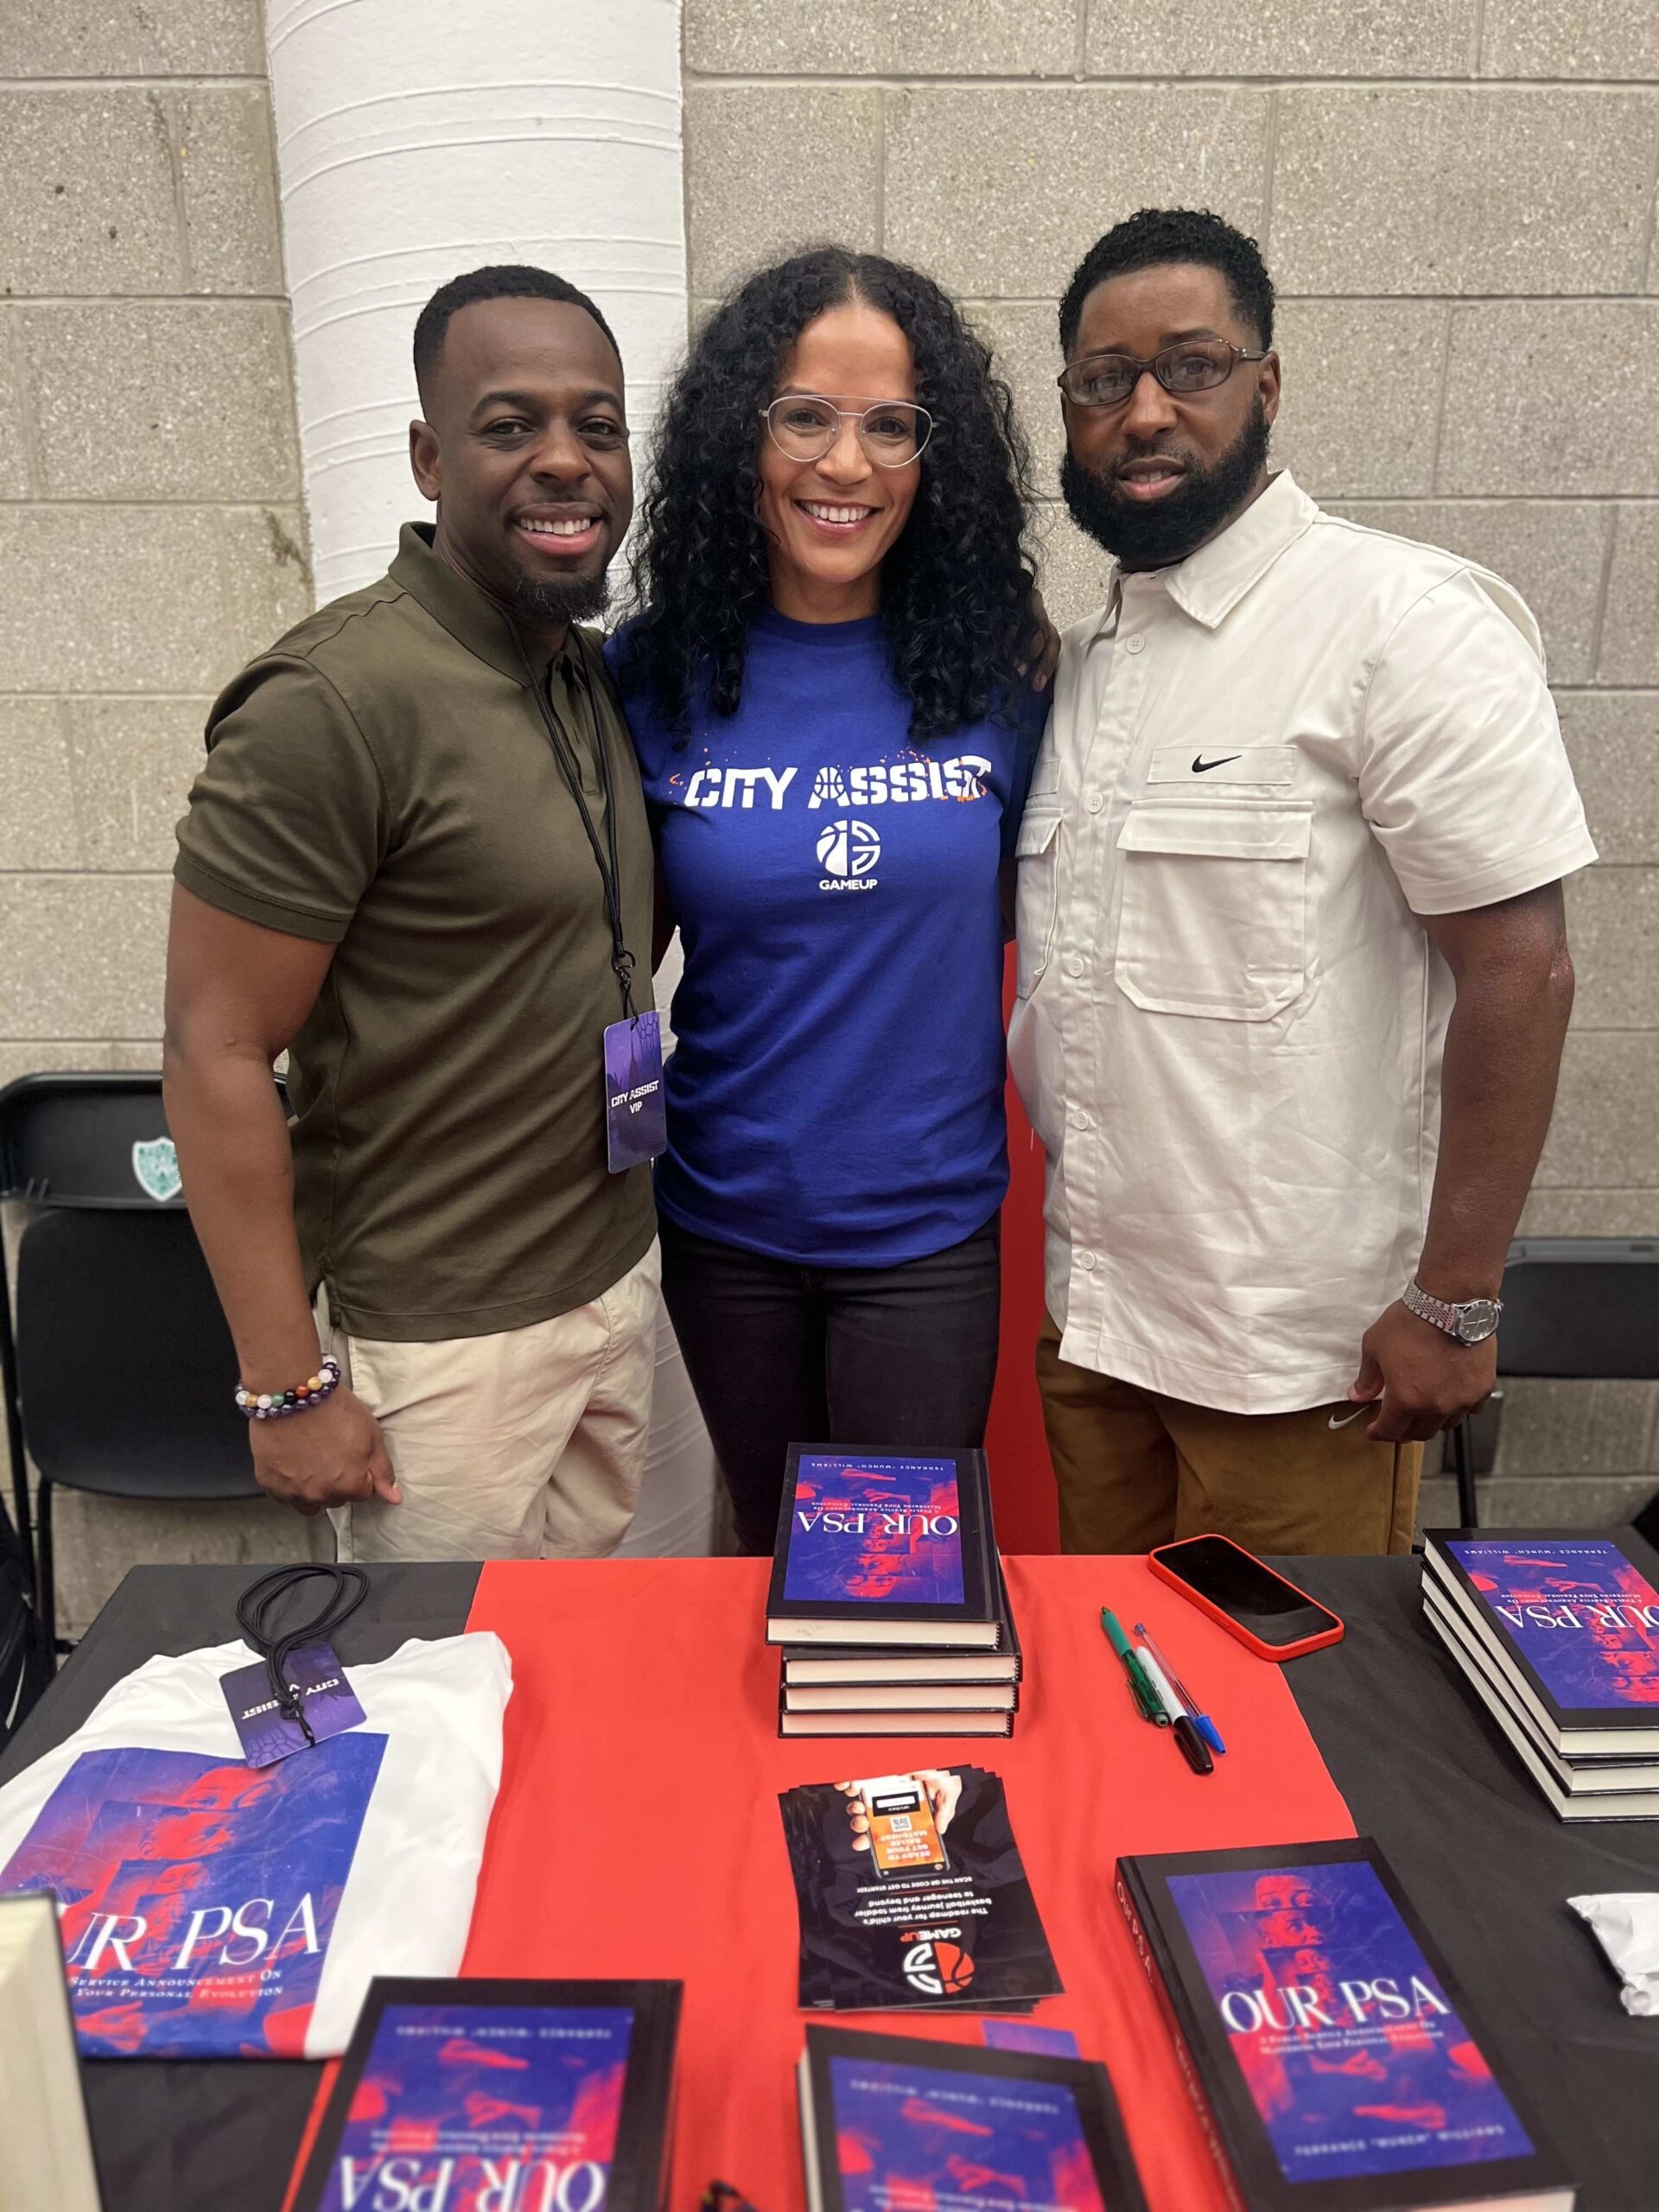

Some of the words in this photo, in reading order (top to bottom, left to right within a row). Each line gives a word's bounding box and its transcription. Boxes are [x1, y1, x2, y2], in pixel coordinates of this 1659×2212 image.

[683, 767, 798, 810] CITY
[808, 755, 992, 809] ASSIST
[819, 879, 878, 890] GAMEUP
[611, 1091, 628, 1108] CITY
[629, 1079, 659, 1101] ASSIST
[629, 1101, 643, 1114] VIP
[798, 1511, 864, 1534] PSA
[880, 1513, 957, 1535] OUR
[1494, 1605, 1584, 1629] PSA
[305, 1678, 340, 1695] CITY
[868, 1898, 901, 1908] beyond
[904, 1896, 920, 1904] and
[922, 1892, 963, 1902] teenager
[945, 1897, 992, 1909] basketball
[855, 1908, 887, 1917] toddler
[890, 1904, 910, 1913] from
[911, 1901, 944, 1911] journey
[929, 1908, 969, 1919] roadmap
[863, 1916, 892, 1926] child's
[170, 1892, 321, 1970] PSA
[900, 1928, 962, 1942] GAMEUP
[134, 1974, 257, 1987] ANNOUNCEMENT
[260, 1969, 282, 1981] ON
[76, 1988, 114, 1997] YOUR
[120, 1988, 194, 1998] PERSONAL
[199, 1986, 283, 1999] EVOLUTION
[1220, 1986, 1335, 2033] OUR
[1338, 1975, 1451, 2023] PSA
[339, 2155, 455, 2212] PSA
[476, 2159, 606, 2212] OUR
